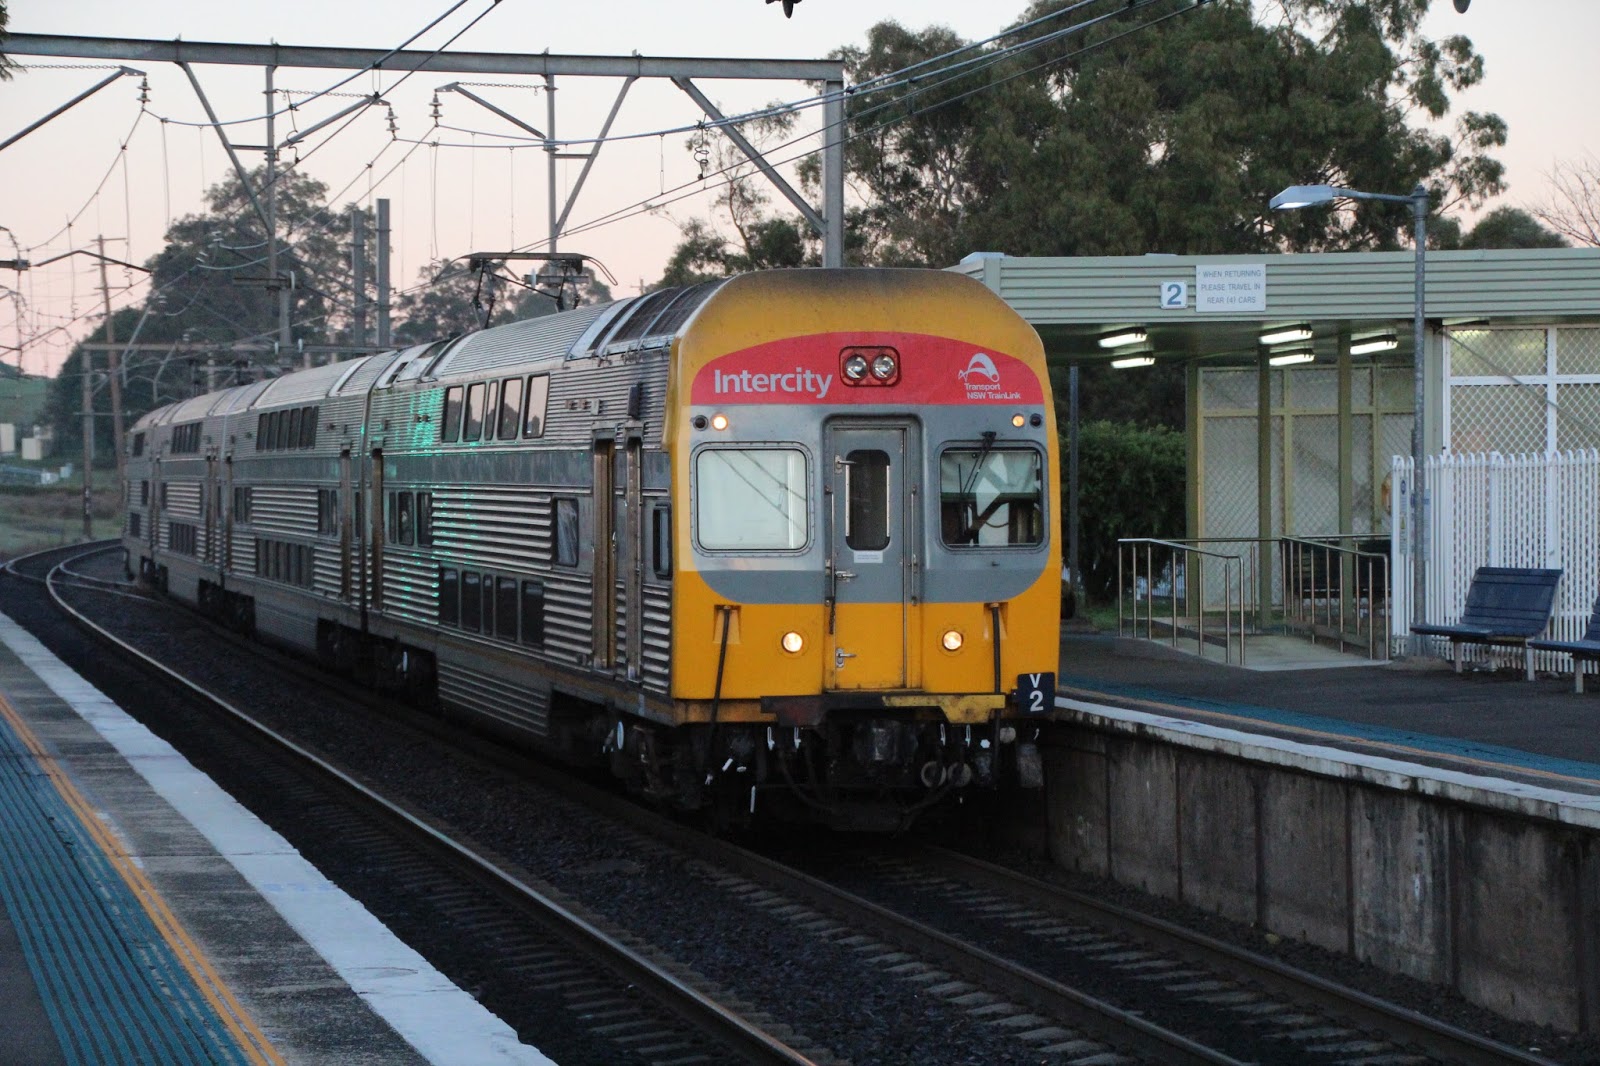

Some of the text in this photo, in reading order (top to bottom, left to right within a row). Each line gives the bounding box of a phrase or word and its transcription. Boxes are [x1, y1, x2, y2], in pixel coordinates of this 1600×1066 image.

[1224, 270, 1261, 278] RETURNING
[1167, 284, 1182, 305] 2
[714, 367, 833, 398] Intercity
[964, 382, 1000, 392] Transport
[966, 392, 1020, 400] NSW TrainLink
[1030, 674, 1041, 688] V
[1030, 690, 1044, 712] 2
